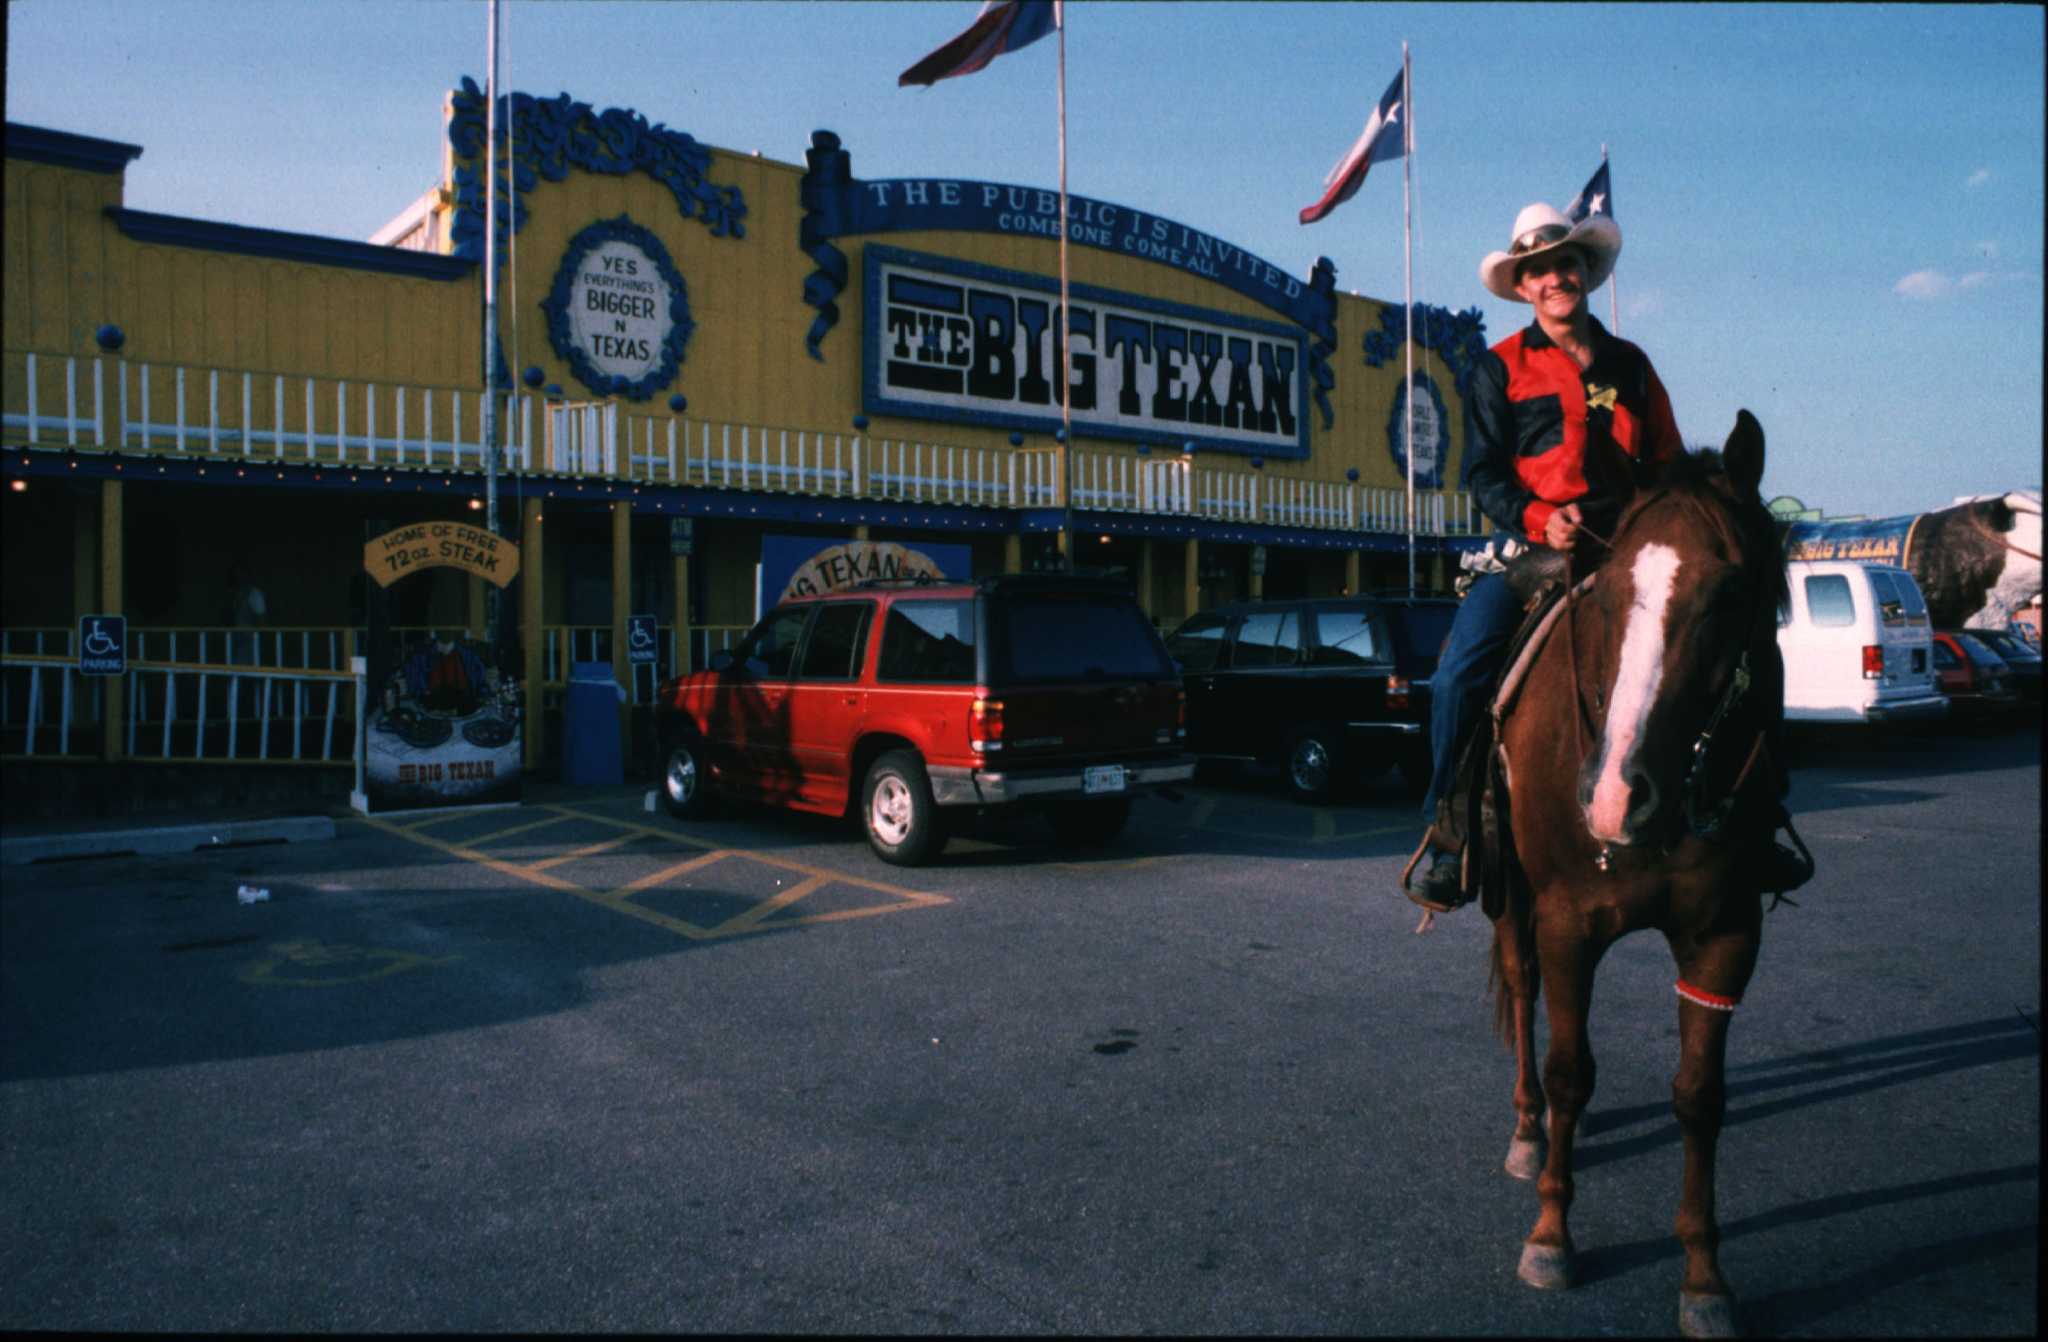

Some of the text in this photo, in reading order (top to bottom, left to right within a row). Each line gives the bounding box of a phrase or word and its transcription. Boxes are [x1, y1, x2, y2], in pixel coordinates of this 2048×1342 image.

[868, 181, 1301, 289] THE PUBLIC IS INVITED
[999, 212, 1220, 277] COME ONE COME ALL
[602, 256, 638, 276] YES
[587, 290, 655, 320] BIGGER
[615, 319, 626, 333] N
[592, 334, 650, 361] TEXAS
[887, 288, 1296, 437] THE BIG TEXAN
[383, 524, 498, 551] HOME OF FREE
[440, 541, 499, 573] STEAK
[815, 551, 902, 589] TEXAN
[448, 761, 494, 780] TEXAN
